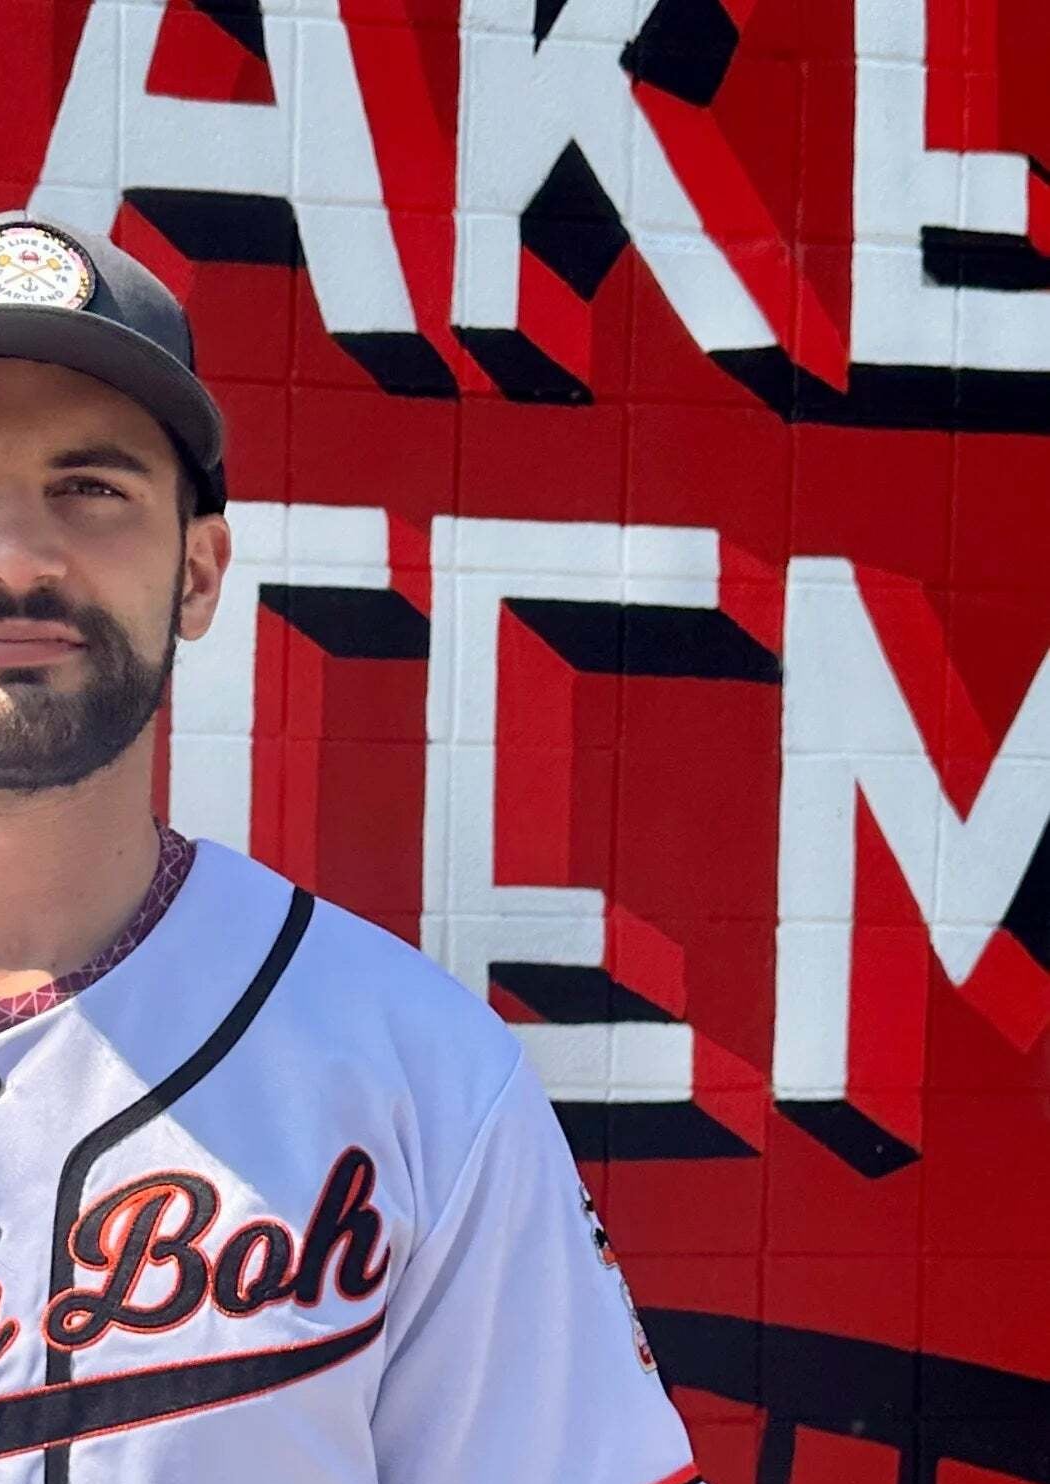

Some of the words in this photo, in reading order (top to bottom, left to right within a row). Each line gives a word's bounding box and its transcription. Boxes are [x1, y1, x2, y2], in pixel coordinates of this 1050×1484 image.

[7, 238, 39, 248] LINE
[42, 243, 73, 272] STATE
[42, 1145, 391, 1352] Boh
